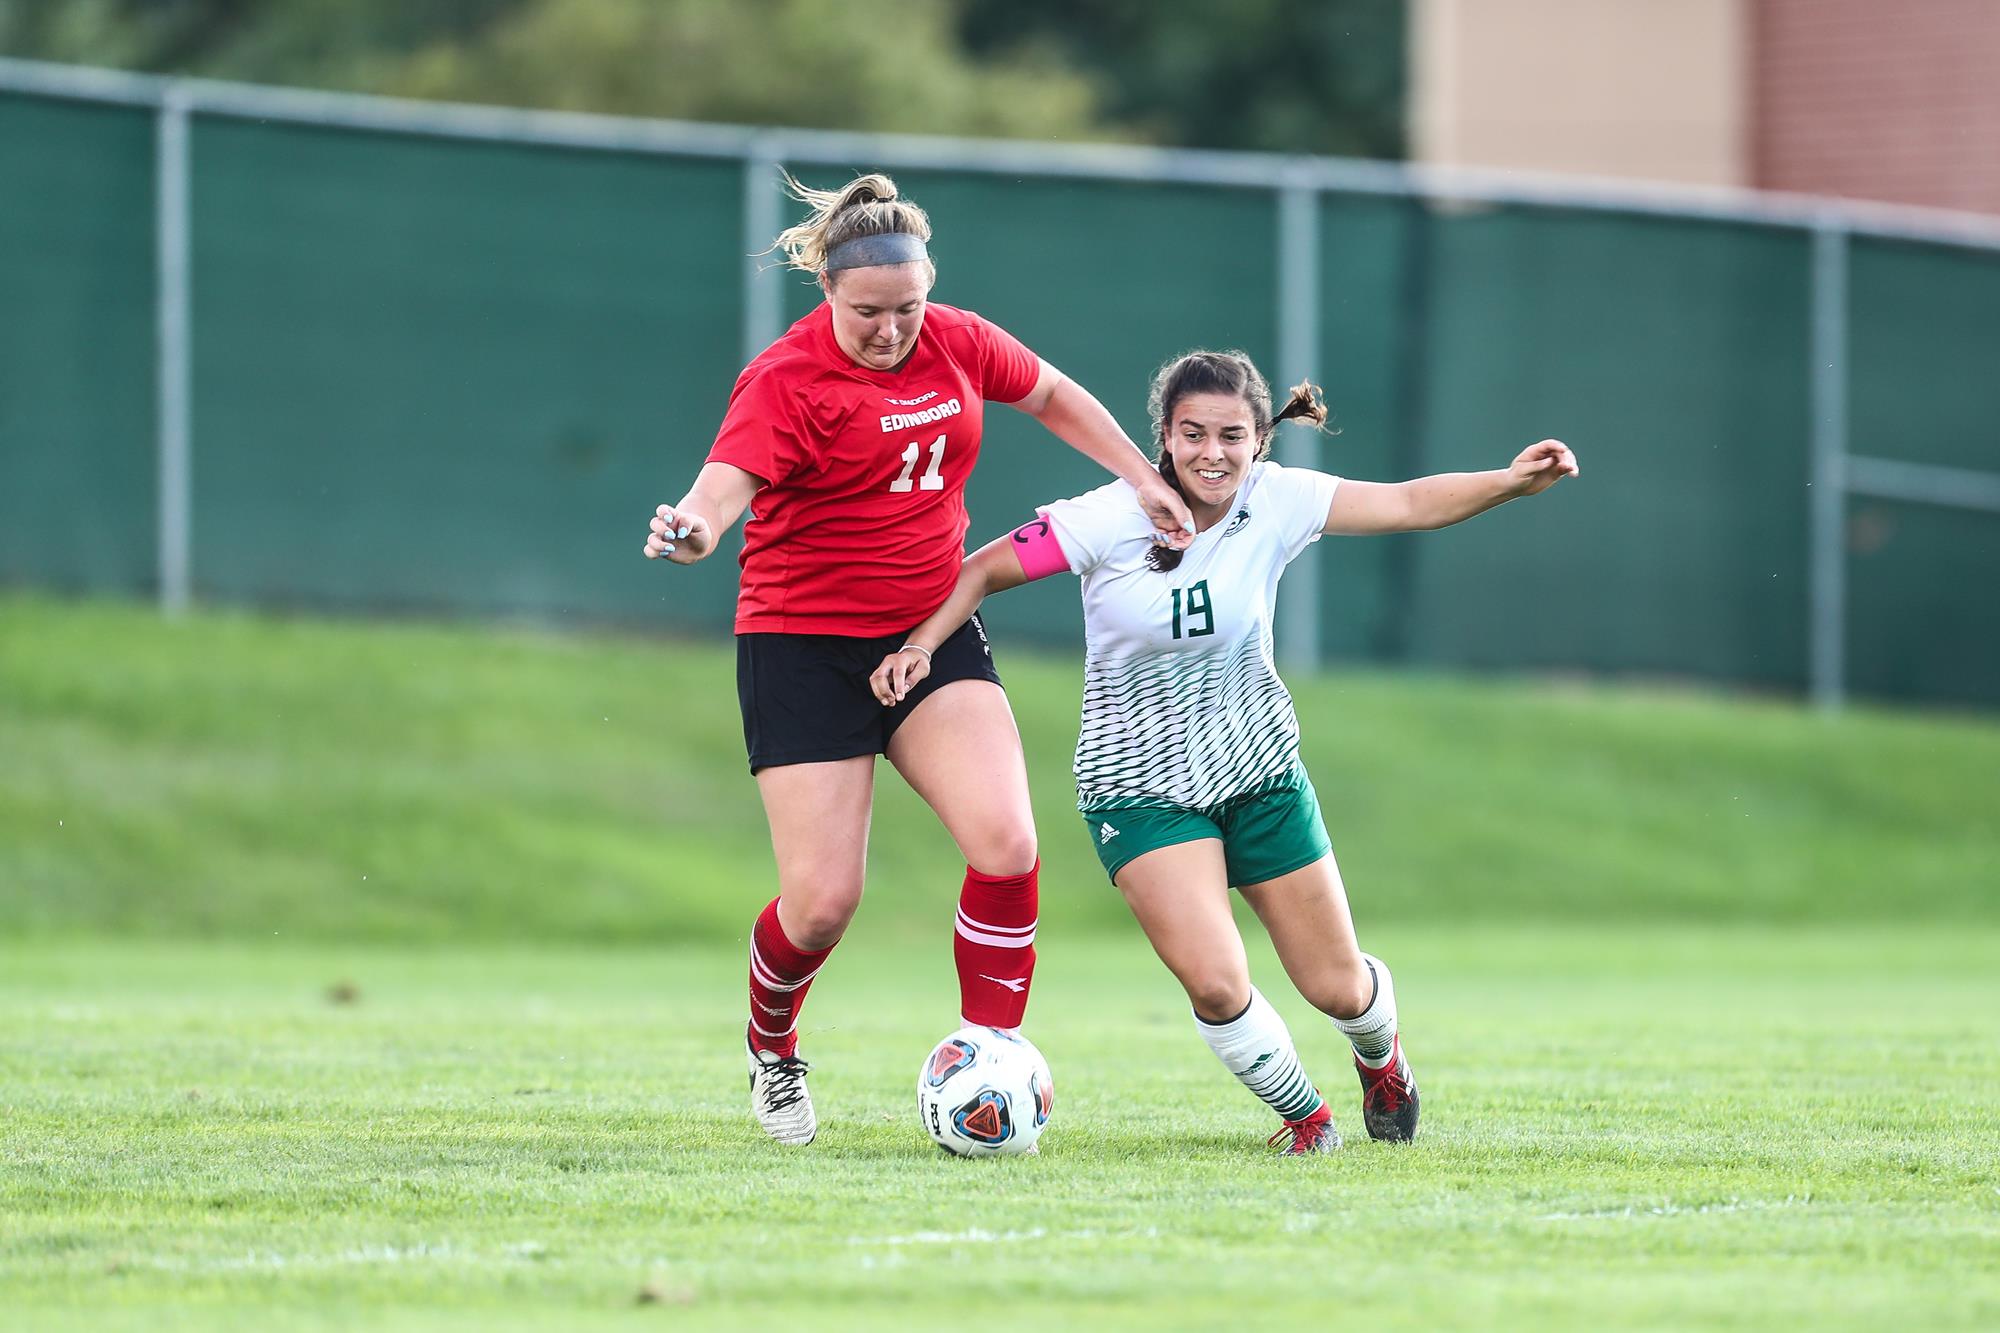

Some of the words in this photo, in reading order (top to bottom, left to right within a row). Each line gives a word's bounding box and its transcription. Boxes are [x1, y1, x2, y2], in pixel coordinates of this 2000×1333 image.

[880, 398, 962, 433] EDINBORO
[889, 434, 947, 492] 11
[1014, 521, 1049, 543] C
[1171, 579, 1215, 640] 19
